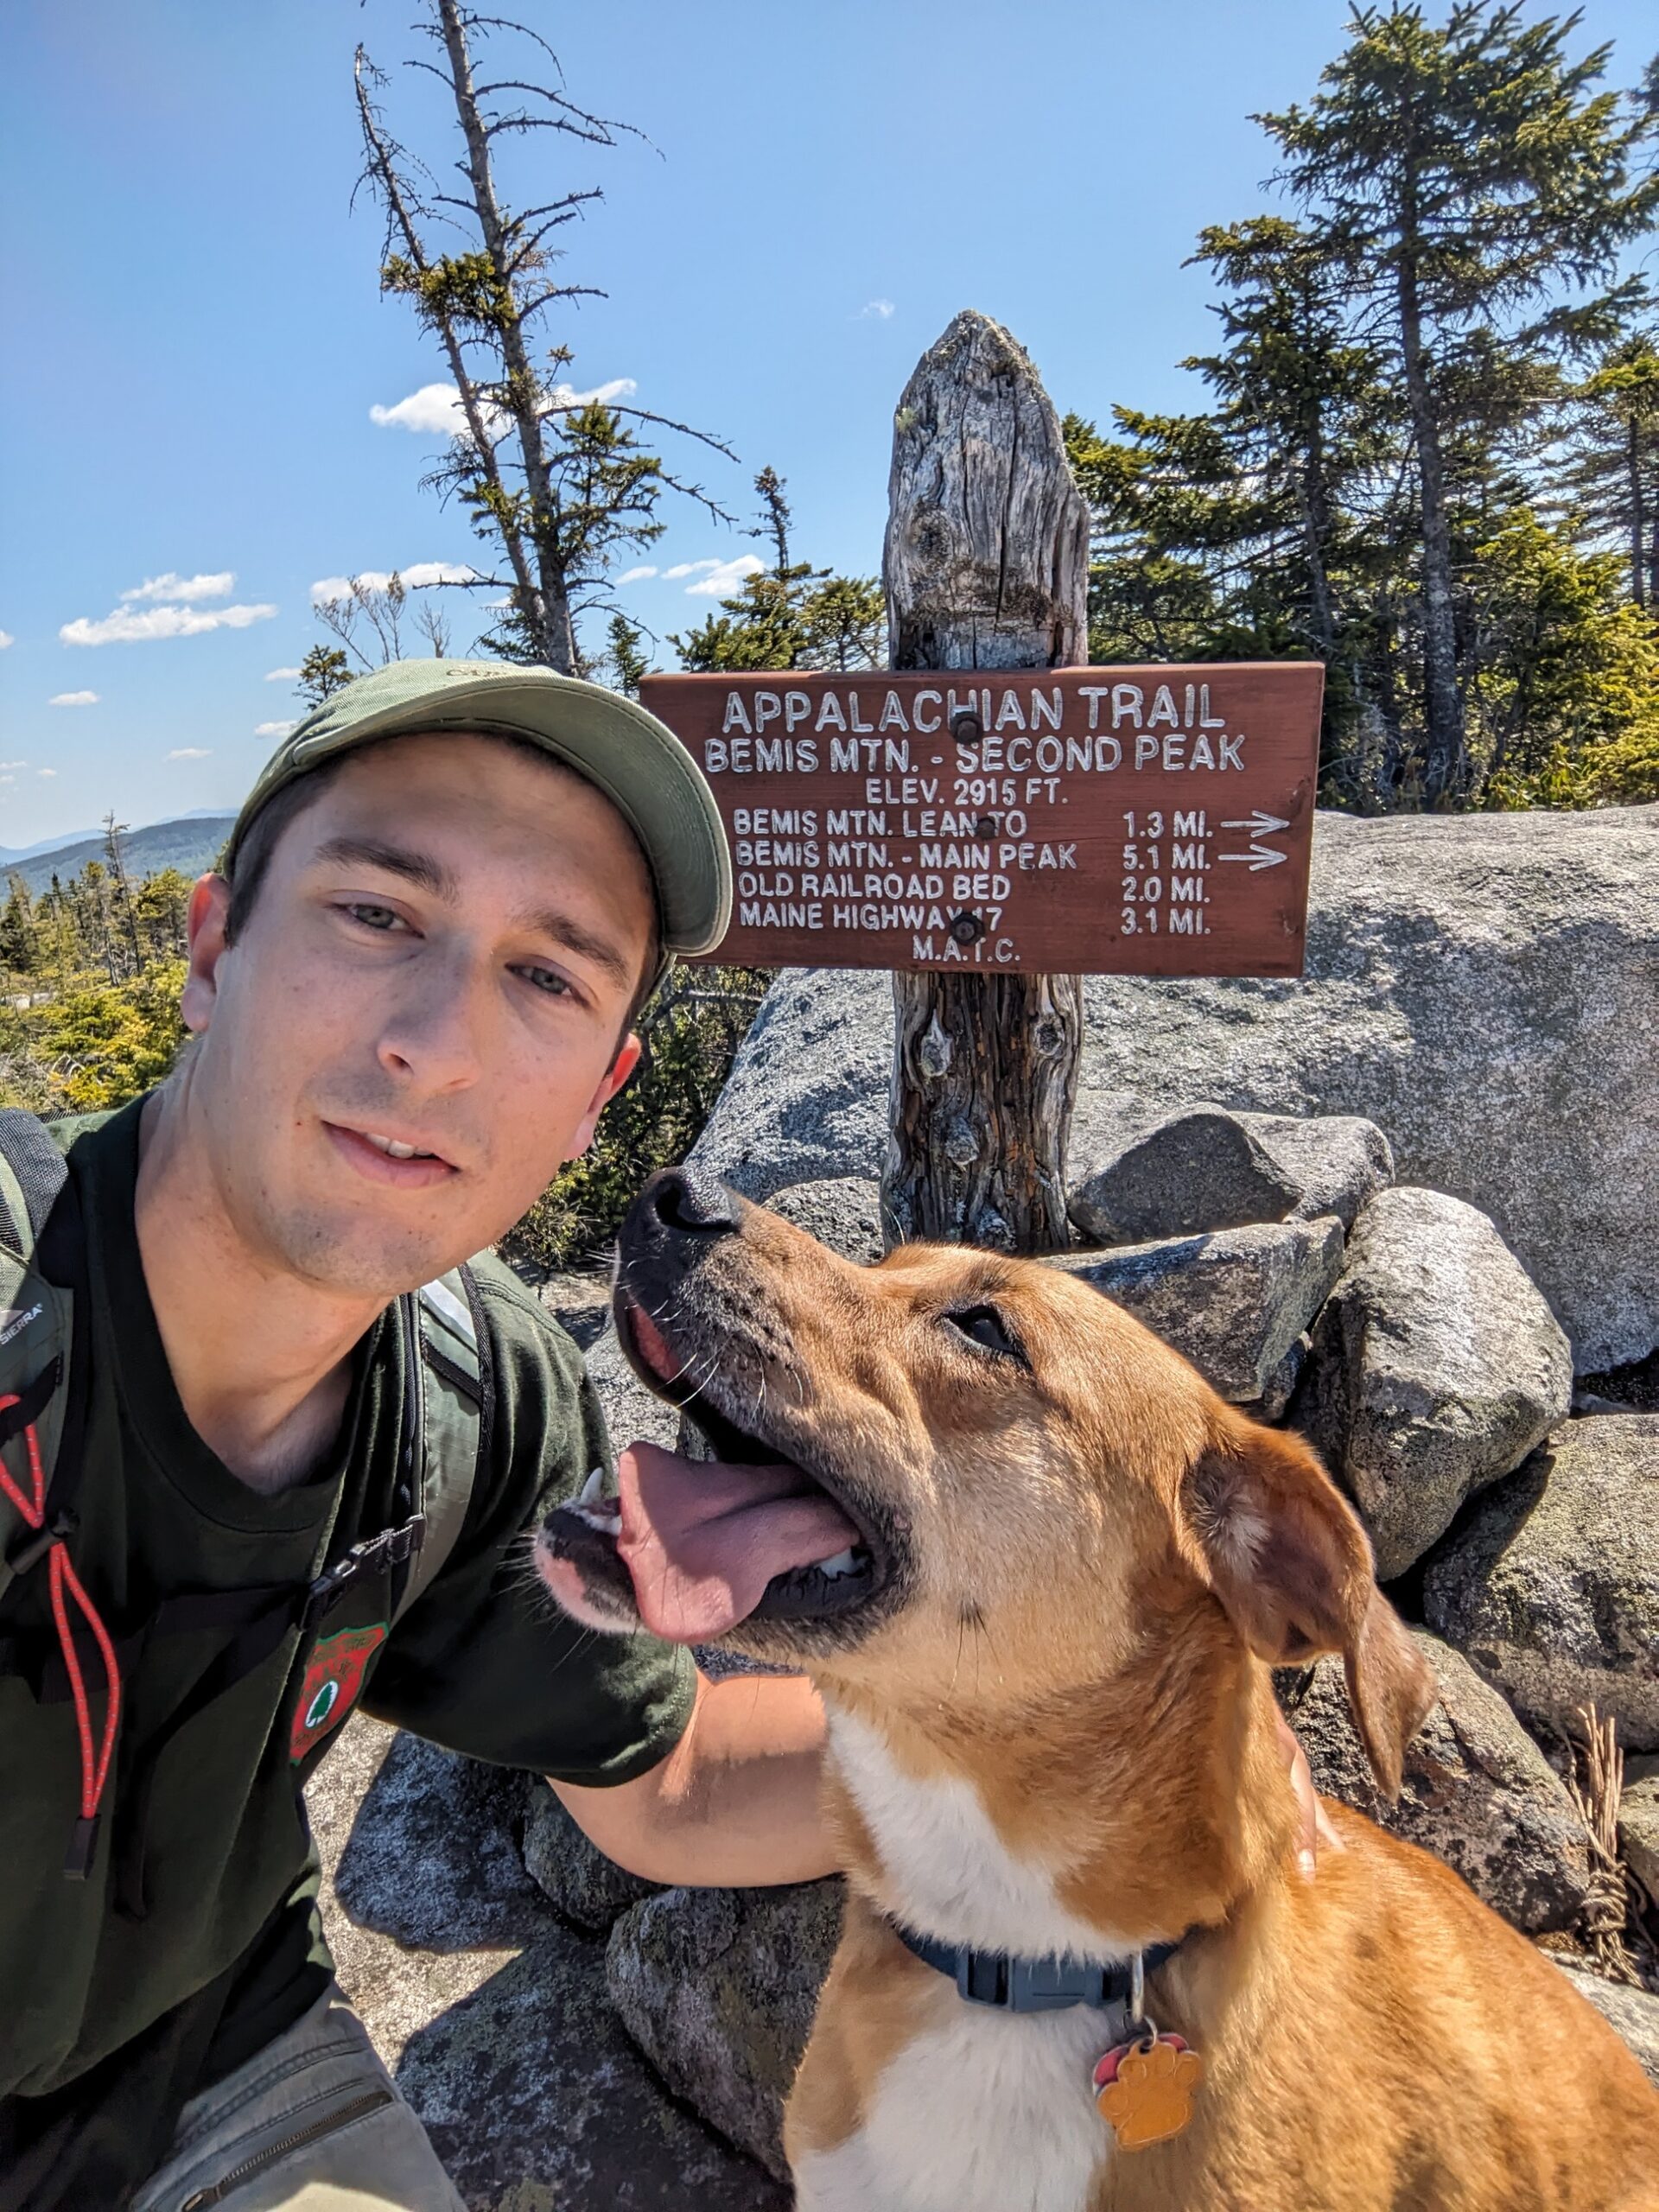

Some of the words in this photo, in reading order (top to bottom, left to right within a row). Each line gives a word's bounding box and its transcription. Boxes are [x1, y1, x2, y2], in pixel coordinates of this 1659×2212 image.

[722, 687, 1064, 734] APPALACHIAN
[1077, 683, 1226, 729] TRAIL
[705, 737, 819, 773] BEMIS
[830, 737, 919, 773] MTN.
[956, 734, 1122, 774] SECOND
[1135, 734, 1246, 772] PEAK
[866, 778, 945, 804] ELEV.
[954, 779, 1017, 806] 2915
[1025, 778, 1069, 804] FT.
[734, 808, 818, 836] BEMIS
[827, 810, 894, 836] MTN.
[1122, 810, 1165, 839] 1.3
[1173, 810, 1213, 838] MI.
[736, 840, 821, 868] BEMIS
[827, 840, 894, 869] MTN.
[919, 842, 990, 870] MAIN
[998, 842, 1077, 870] PEAK
[1122, 843, 1160, 871] 5.1
[1171, 842, 1211, 870] MI.
[738, 871, 795, 899] OLD
[801, 872, 944, 901] RAILROAD
[952, 874, 1011, 901] BED
[1121, 875, 1162, 903] 2.0
[1170, 875, 1211, 904] MI.
[739, 901, 824, 930] MAINE
[1121, 906, 1158, 936] 3.1
[1168, 907, 1211, 936] MI.
